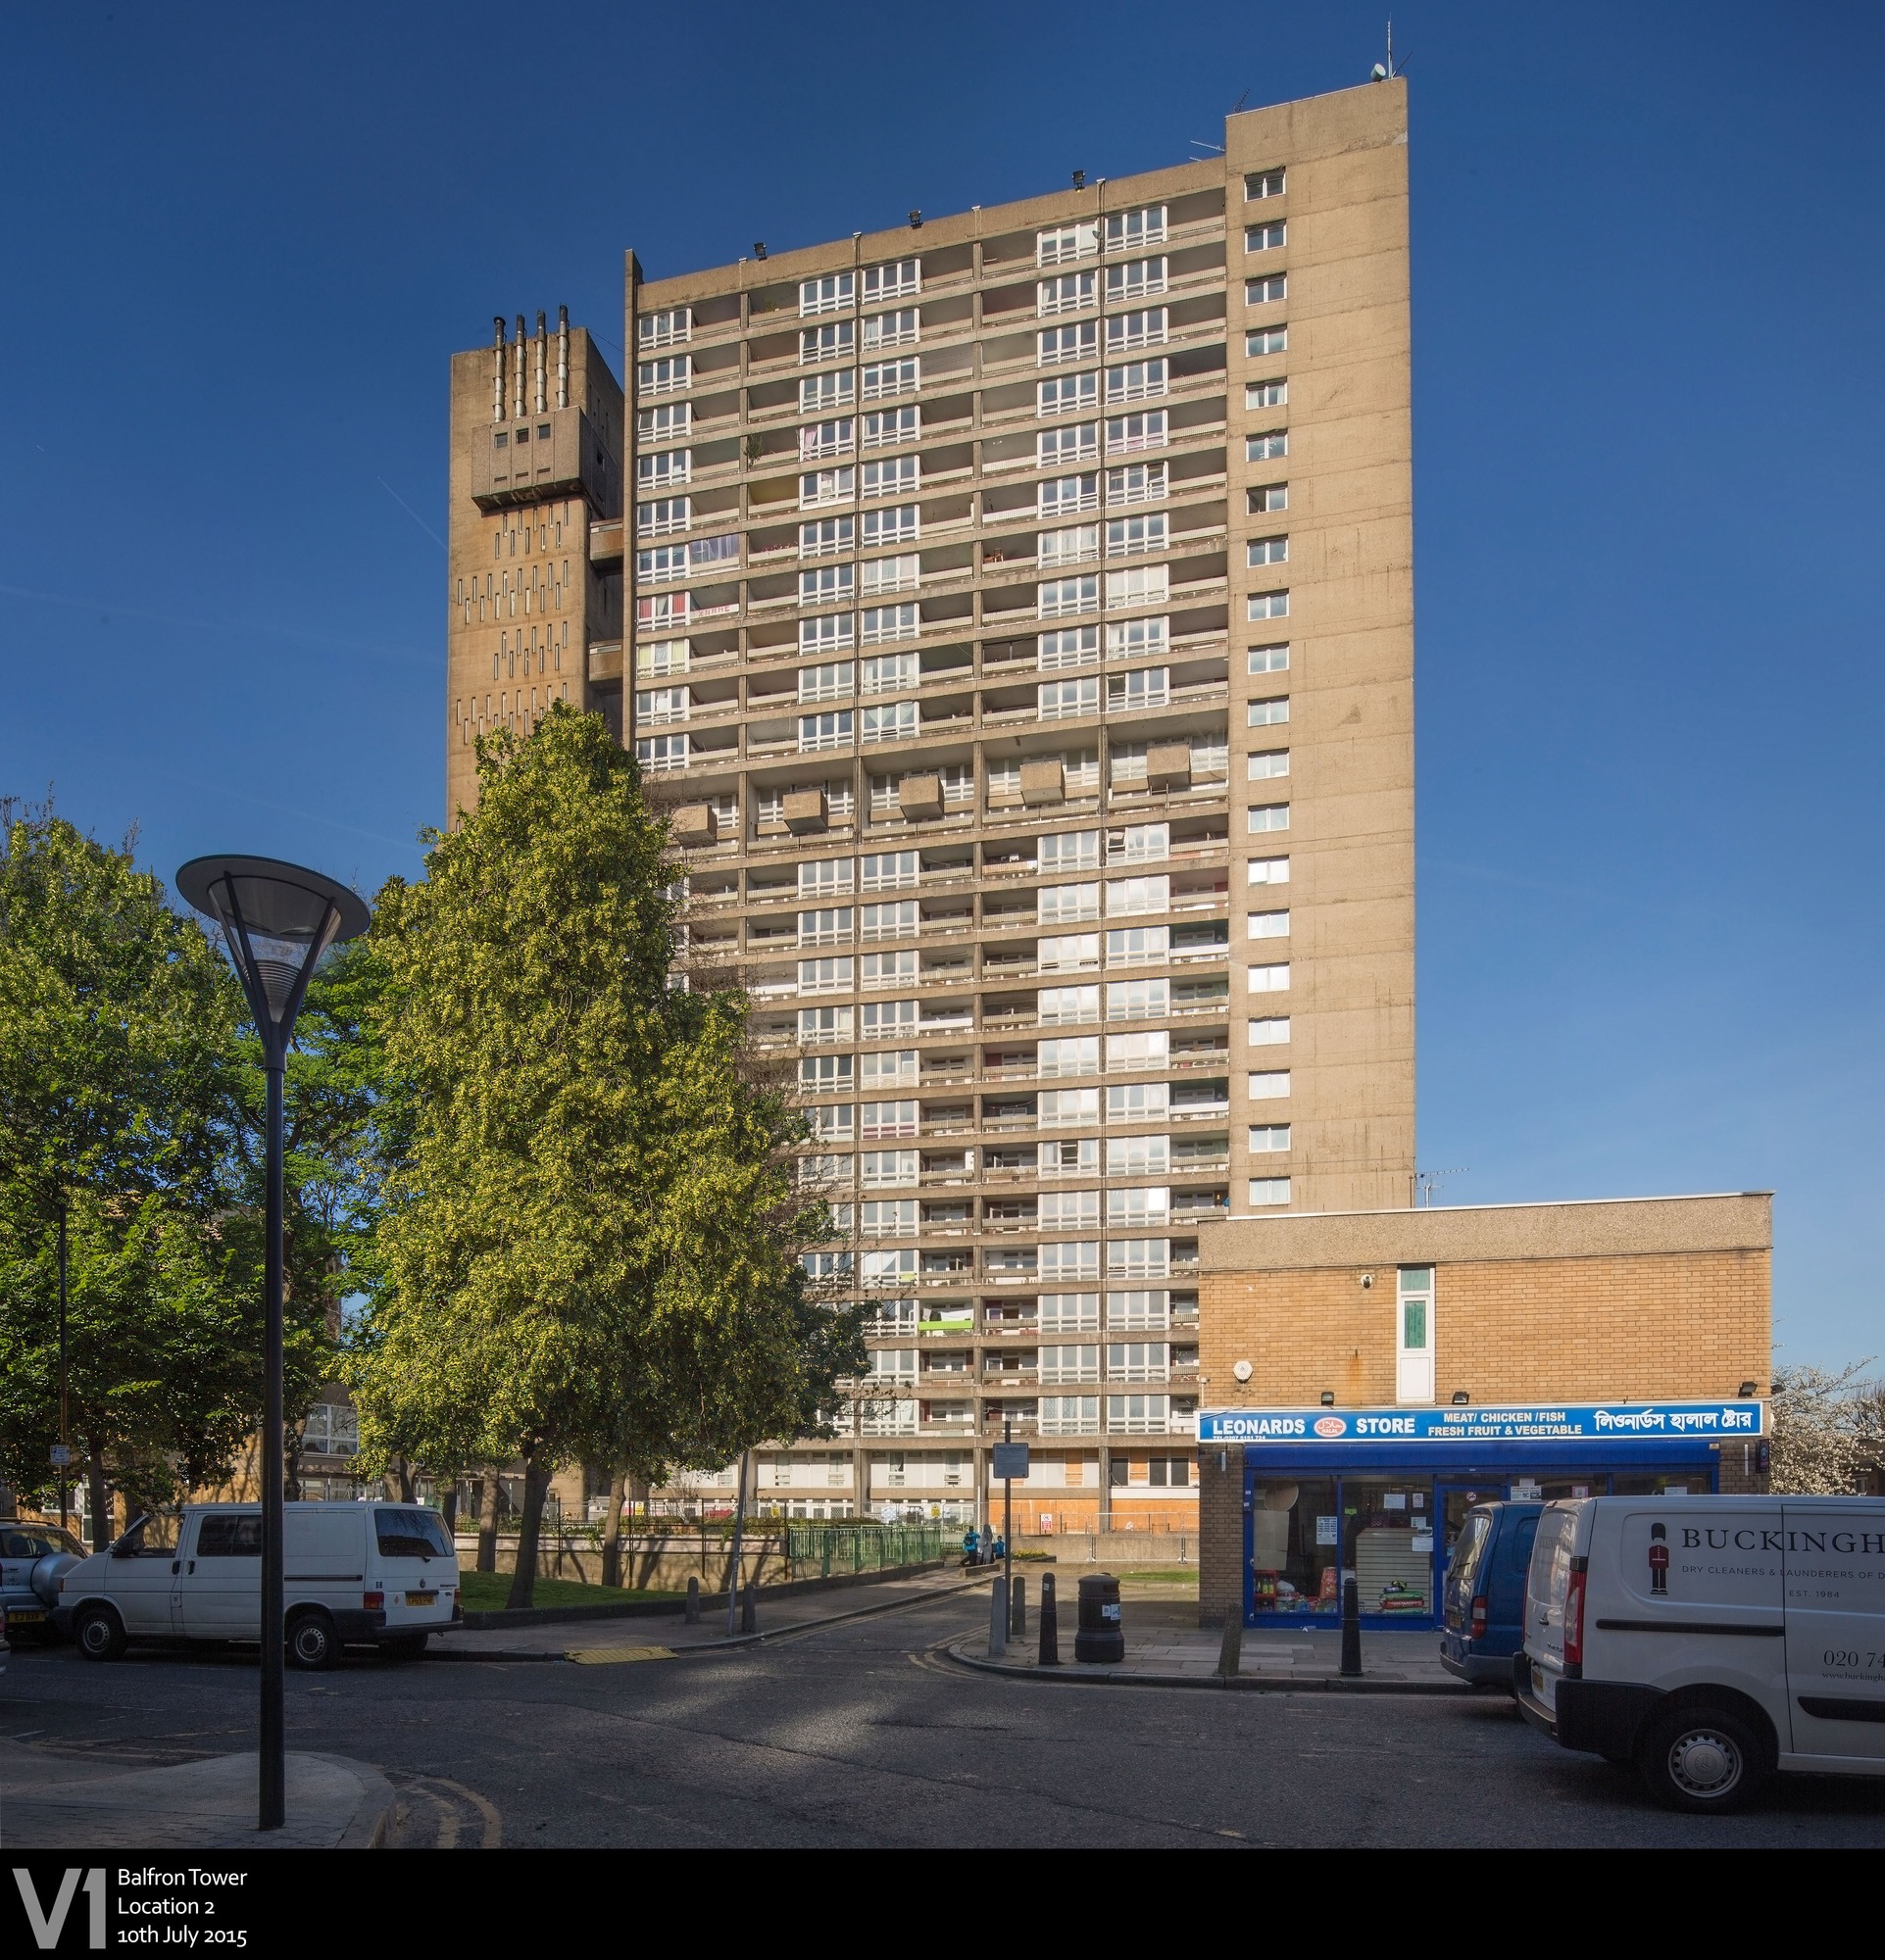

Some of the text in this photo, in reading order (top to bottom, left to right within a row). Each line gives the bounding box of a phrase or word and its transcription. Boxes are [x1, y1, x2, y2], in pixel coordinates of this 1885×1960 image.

[1443, 1412, 1477, 1423] MEAT/
[1480, 1412, 1532, 1423] CHICKEN
[1668, 1412, 1719, 1432] হালাল
[1213, 1417, 1415, 1436] LEONARDS STORE
[1427, 1424, 1582, 1437] FRESH FRUIT & VEGETABLE
[1681, 1528, 1885, 1554] BUCKINGH
[1681, 1565, 1704, 1574] DRY
[1708, 1566, 1765, 1576] CLEANERS
[1768, 1568, 1776, 1577] &
[1779, 1569, 1855, 1579] LAUNDERERS
[1823, 1650, 1859, 1667] 020
